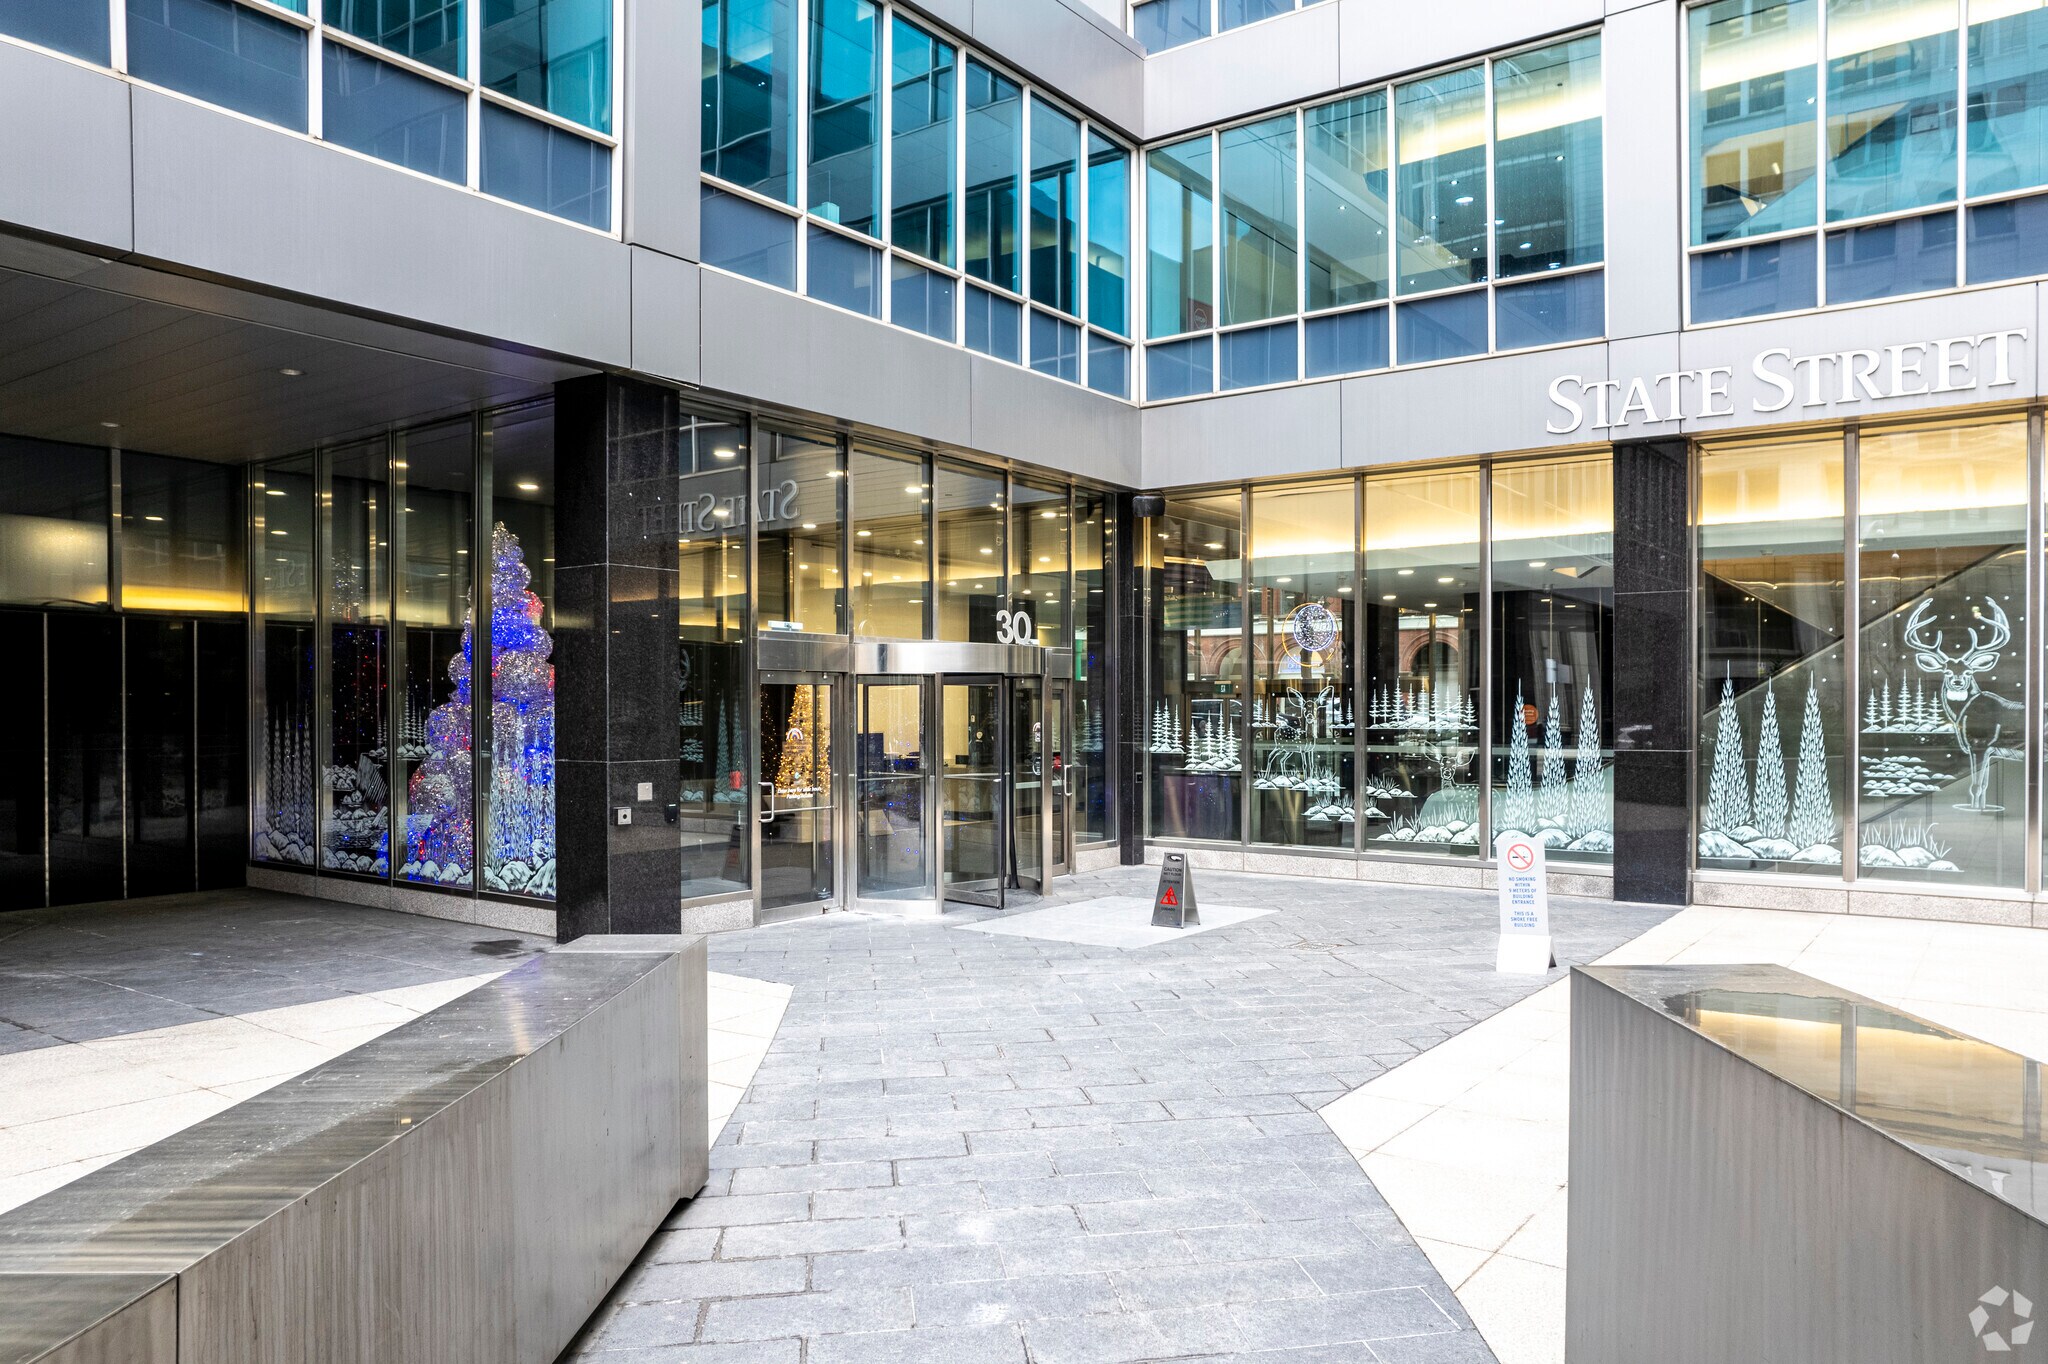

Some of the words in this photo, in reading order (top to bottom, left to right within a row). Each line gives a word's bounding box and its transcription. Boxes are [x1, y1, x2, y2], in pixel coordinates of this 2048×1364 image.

[1546, 366, 1735, 434] STATE
[1752, 327, 2028, 413] STREET
[996, 609, 1032, 645] 30
